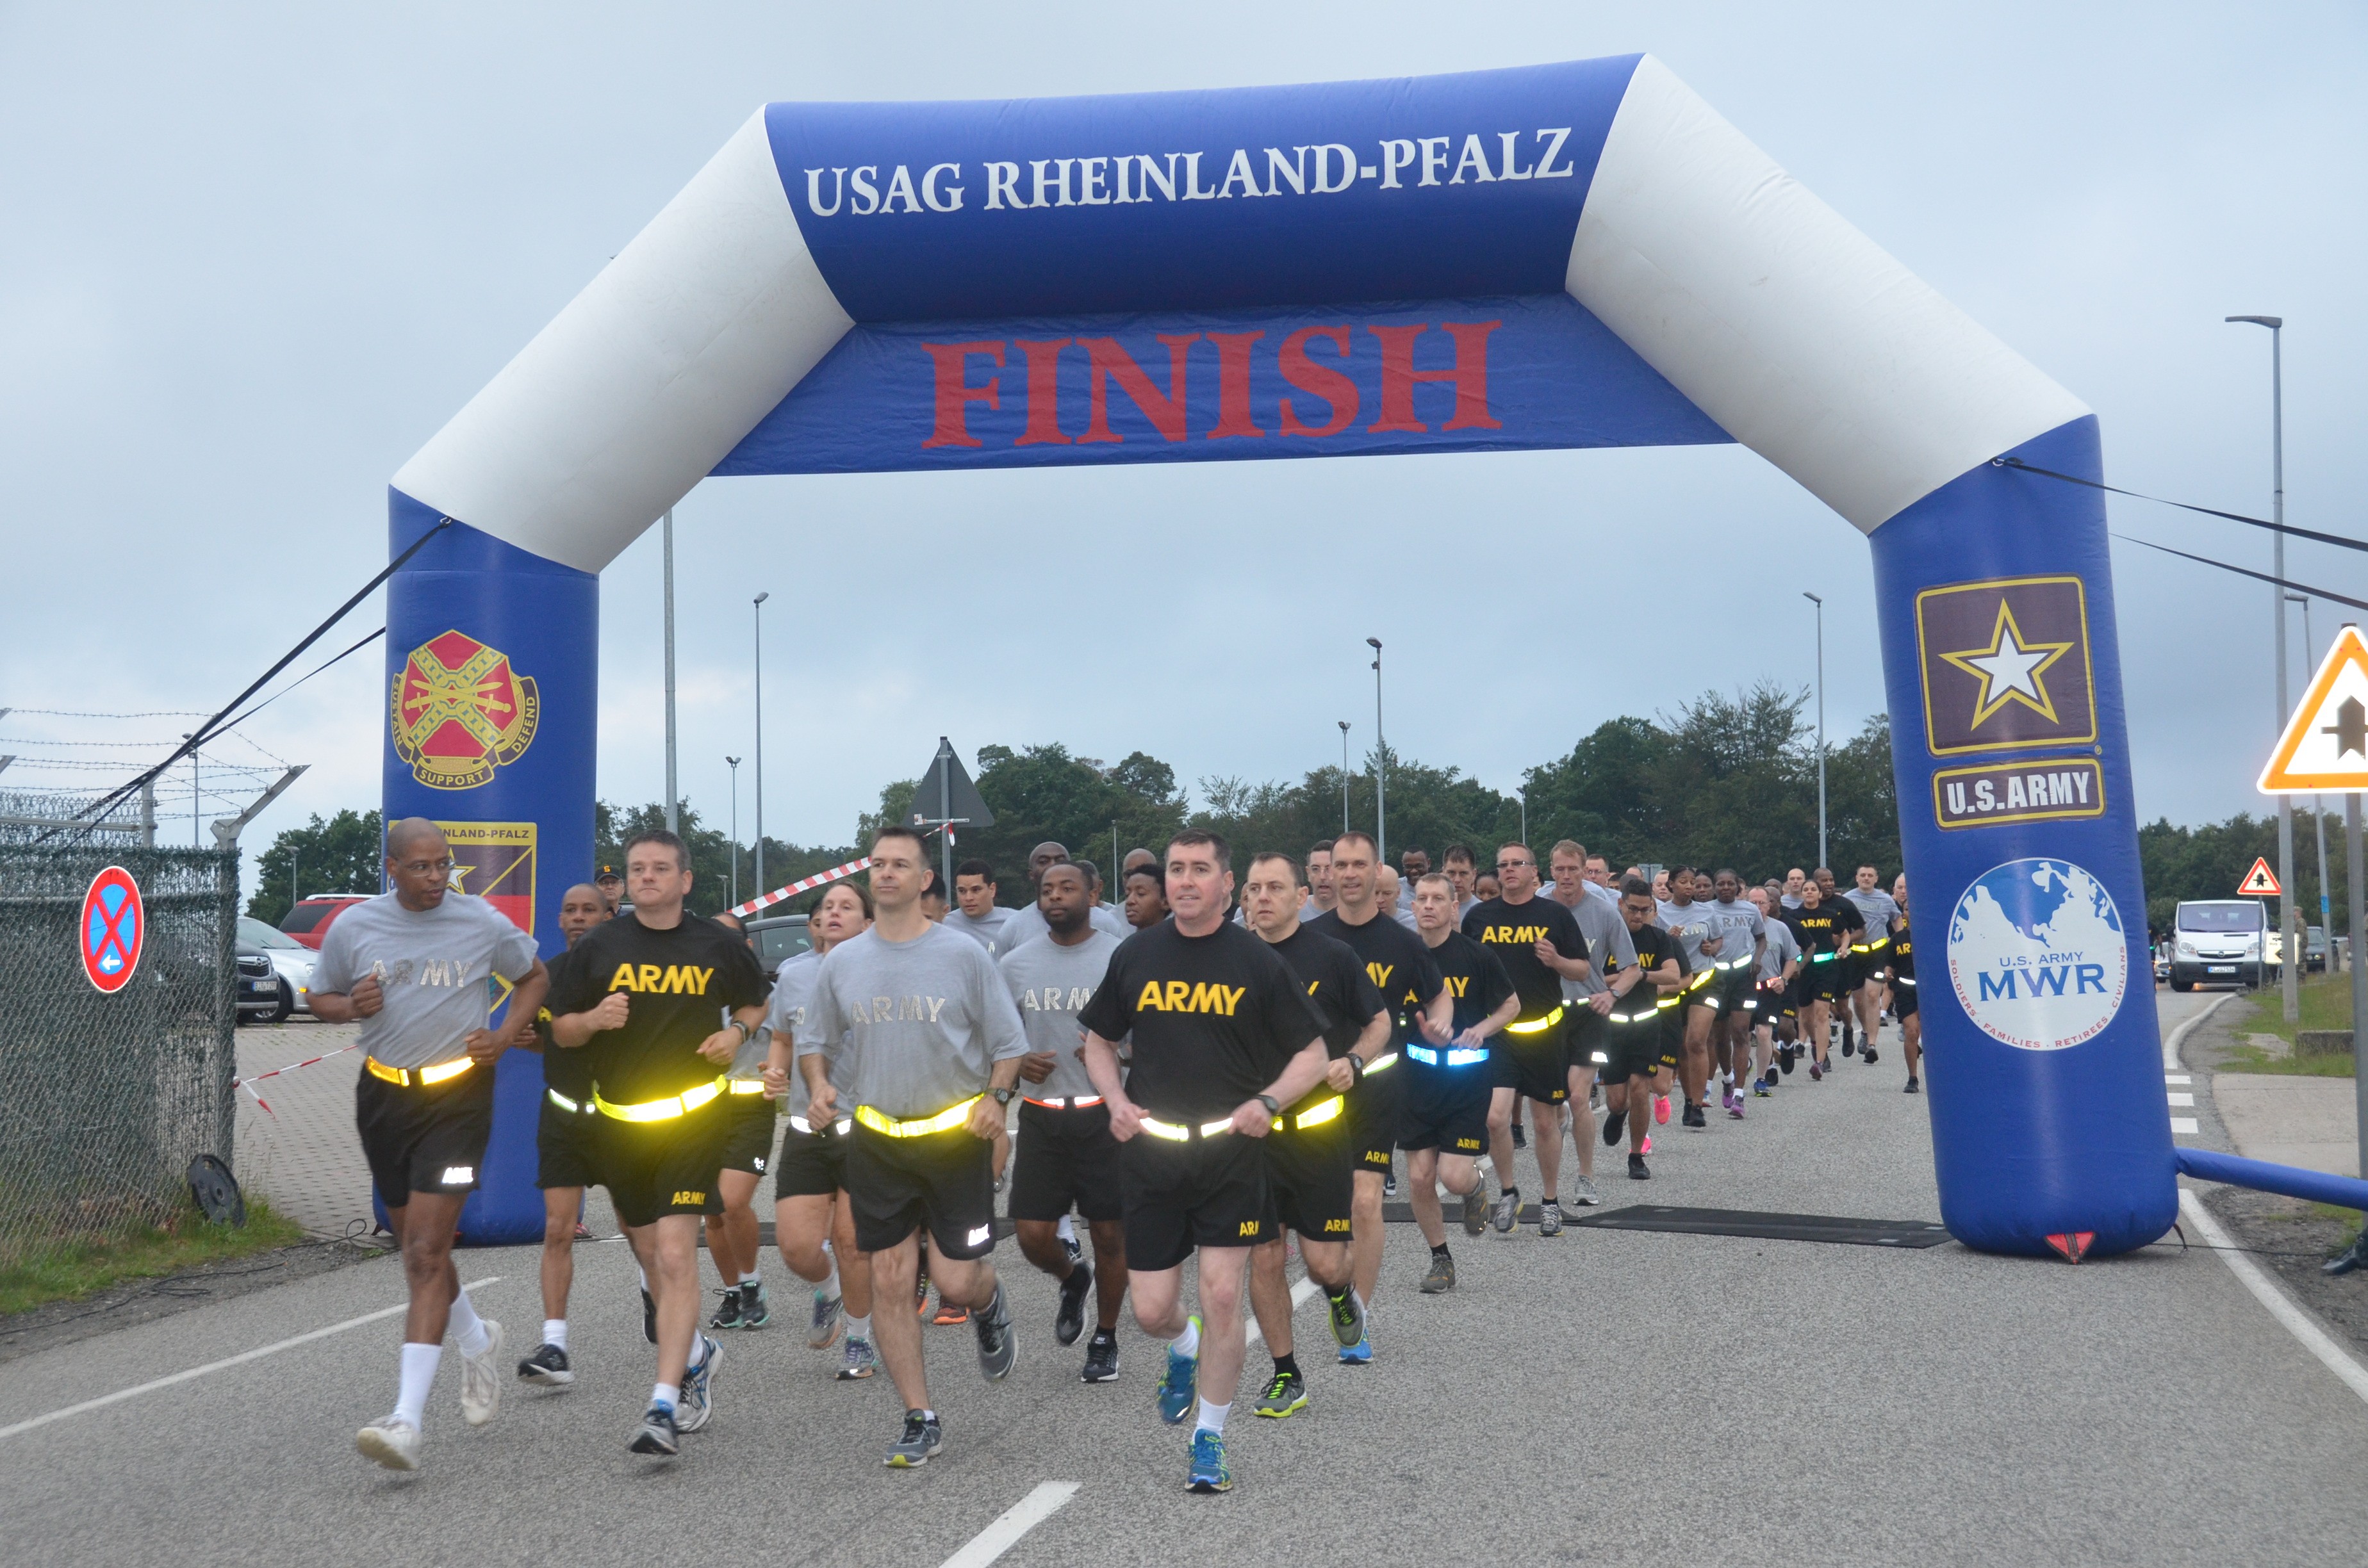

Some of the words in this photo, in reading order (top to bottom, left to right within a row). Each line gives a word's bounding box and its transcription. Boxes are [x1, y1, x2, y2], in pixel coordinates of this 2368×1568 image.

[804, 162, 965, 216] USAG
[982, 127, 1574, 211] RHEINLAND-PFALZ
[921, 320, 1502, 450] FINISH
[391, 682, 403, 747] SUSTAIN
[511, 696, 536, 753] DEFEND
[420, 769, 484, 786] SUPPORT
[441, 828, 529, 838] NLAND-PFALZ
[1481, 926, 1549, 943] ARMY
[1722, 916, 1752, 927] RMY
[1896, 943, 1911, 956] AR
[2000, 956, 2032, 967] U.S.
[2038, 951, 2084, 965] ARMY
[372, 959, 473, 988] ARMY
[607, 963, 714, 995] ARMY
[1950, 959, 1977, 1017] SOLDIERS
[1977, 963, 2109, 1002] MWR
[2111, 945, 2125, 1008] CIVILIANS
[851, 995, 946, 1025] ARMY
[1024, 987, 1098, 1011] ARM
[1136, 981, 1247, 1017] ARMY
[1984, 1022, 2041, 1048] FAMILIES
[2055, 1016, 2109, 1048] RETIREES
[670, 1191, 706, 1205] ARMY
